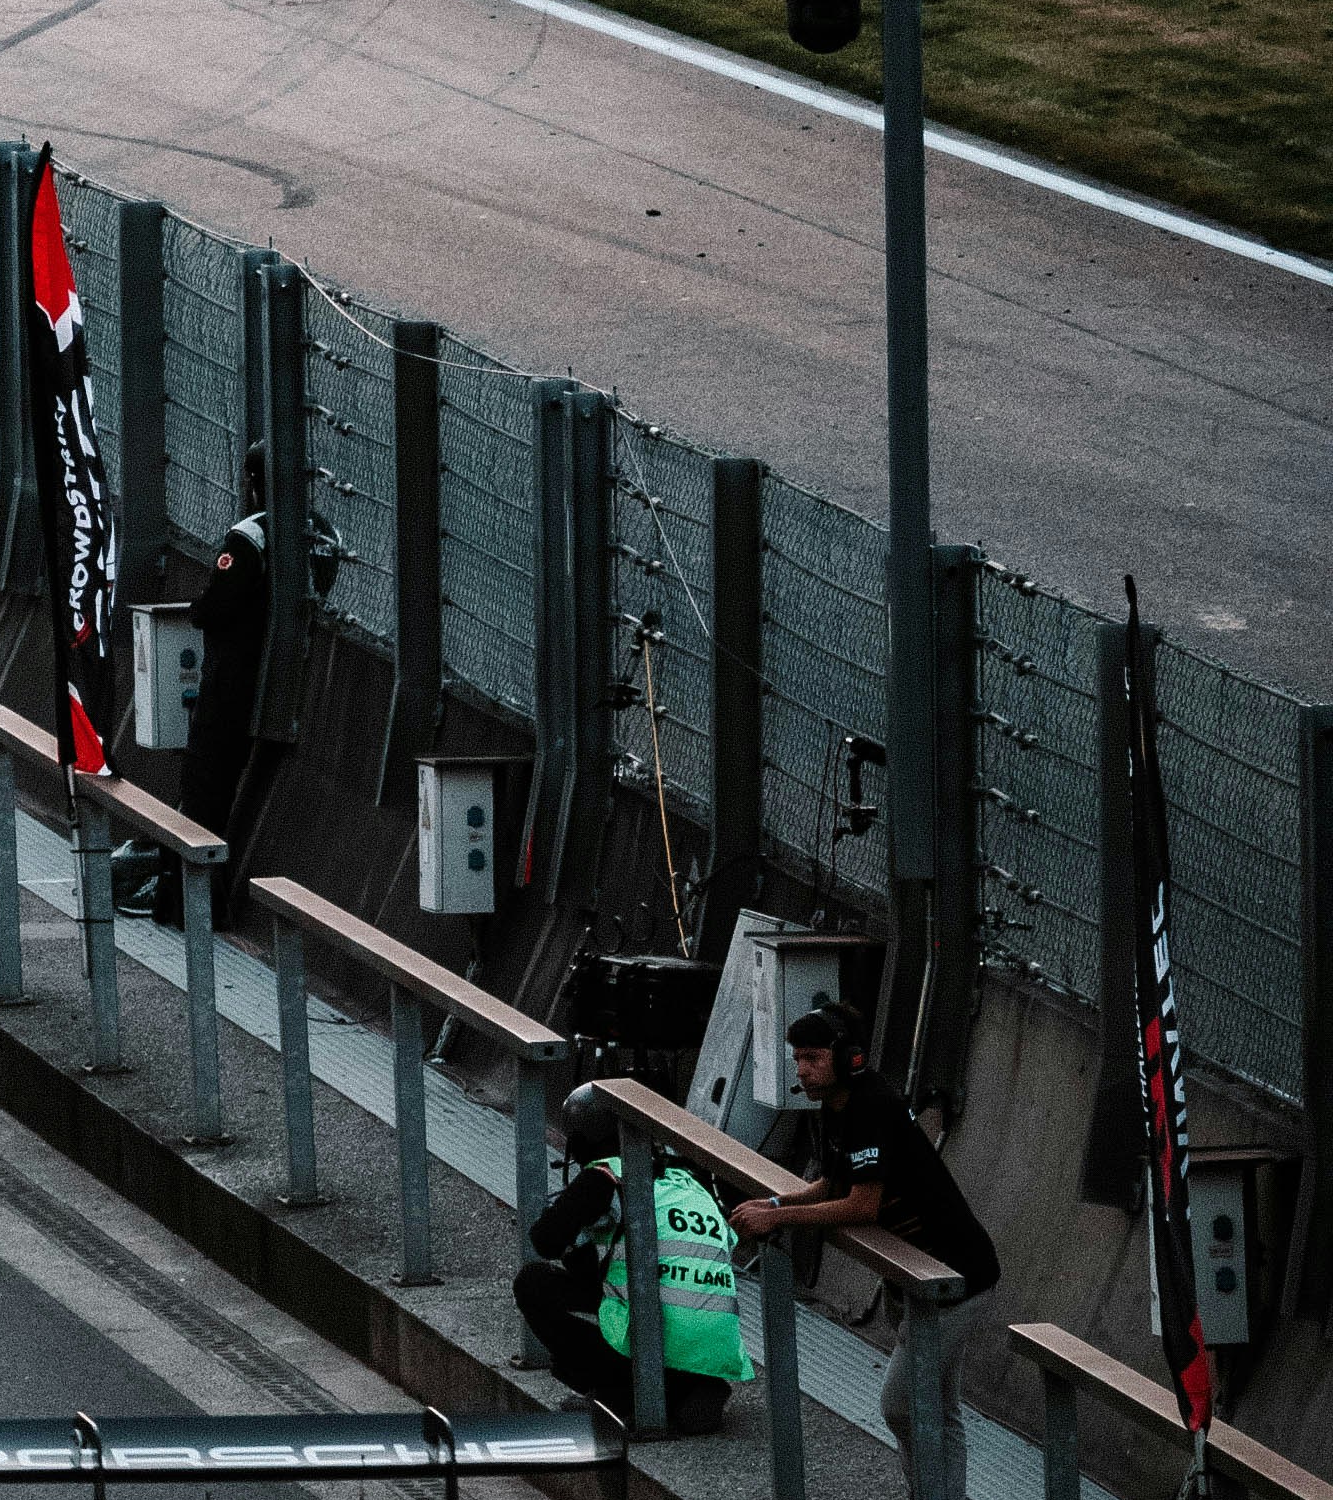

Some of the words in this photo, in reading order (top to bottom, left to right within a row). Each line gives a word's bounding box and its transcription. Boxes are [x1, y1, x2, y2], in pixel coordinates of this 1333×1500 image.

[667, 1208, 723, 1242] 632
[658, 1265, 690, 1283] PIT
[694, 1267, 732, 1288] LANE
